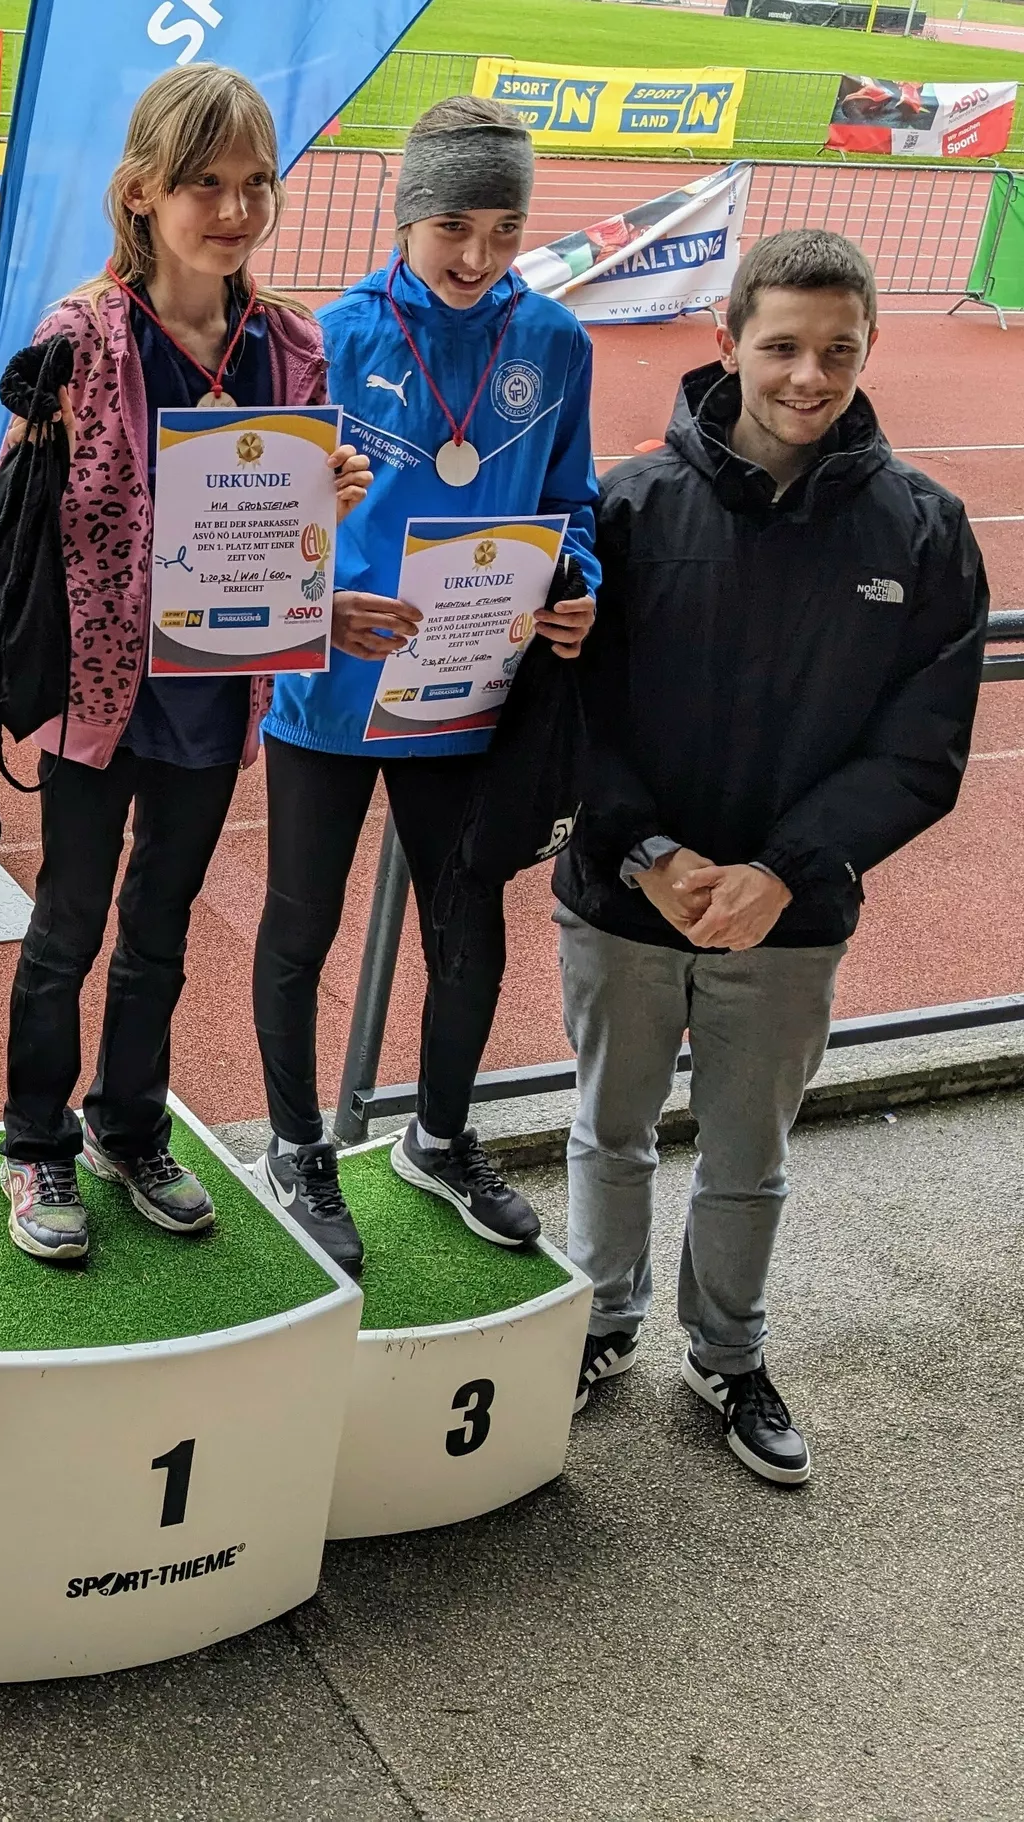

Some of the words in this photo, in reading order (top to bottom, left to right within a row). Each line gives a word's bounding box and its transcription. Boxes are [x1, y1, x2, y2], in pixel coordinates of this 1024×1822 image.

[501, 80, 550, 96] SPORT
[634, 88, 685, 99] SPORT
[515, 111, 539, 124] ND
[631, 115, 668, 128] LAND
[947, 131, 978, 154] Sport!
[358, 428, 421, 468] INTERSPORT
[362, 443, 405, 471] WINNINGER
[206, 473, 291, 488] URKUNDE
[248, 519, 299, 528] SPARKASSEN
[231, 530, 300, 540] LAUFOLMYPIADE
[217, 543, 224, 551] 1.
[226, 543, 252, 551] PLATZ
[254, 542, 269, 550] MIT
[271, 541, 294, 549] EINER
[248, 553, 265, 561] VON
[444, 573, 514, 589] URKUNDE
[872, 578, 889, 587] THE
[223, 585, 264, 593] ERREICHT
[857, 585, 888, 594] NORTH
[864, 592, 887, 601] FACE
[471, 610, 513, 620] SPARKASSEN
[449, 631, 471, 640] PLATZ
[485, 628, 505, 636] EINER
[439, 664, 473, 673] ERREICHT
[444, 1378, 496, 1457] 3
[150, 1438, 196, 1528] 1
